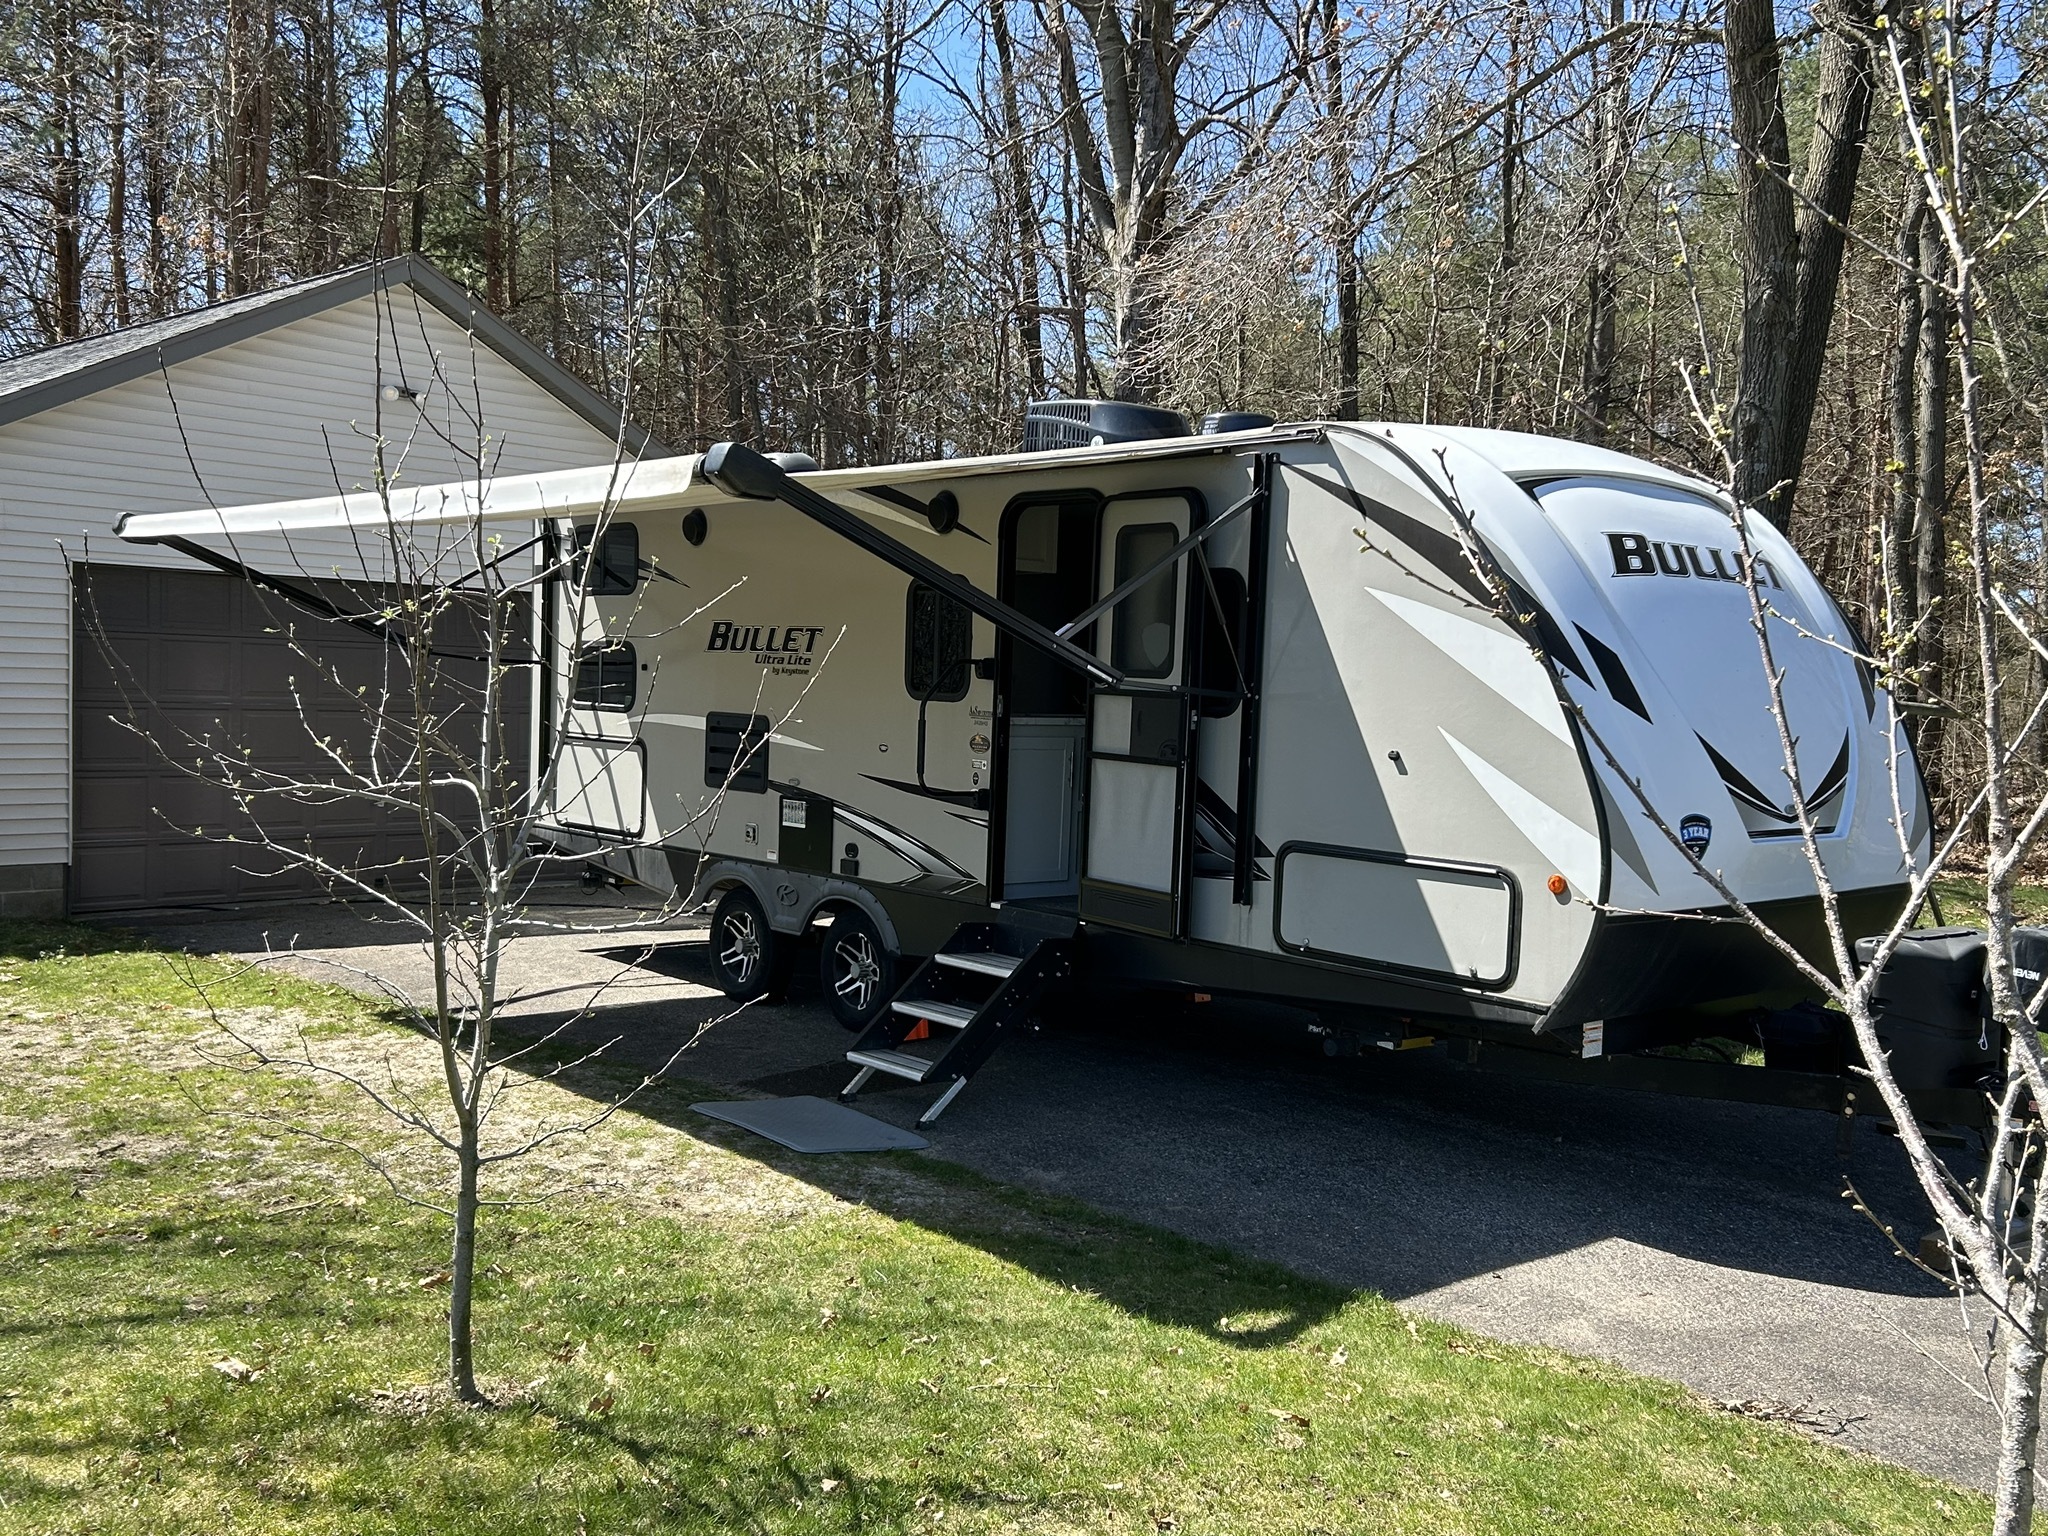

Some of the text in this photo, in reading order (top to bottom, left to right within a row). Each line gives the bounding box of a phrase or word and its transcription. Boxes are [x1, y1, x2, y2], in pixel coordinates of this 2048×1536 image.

[704, 620, 825, 655] BULLET
[755, 654, 811, 666] Ultra Lite
[772, 667, 810, 676] by Keystone
[1688, 826, 1709, 838] YEAR
